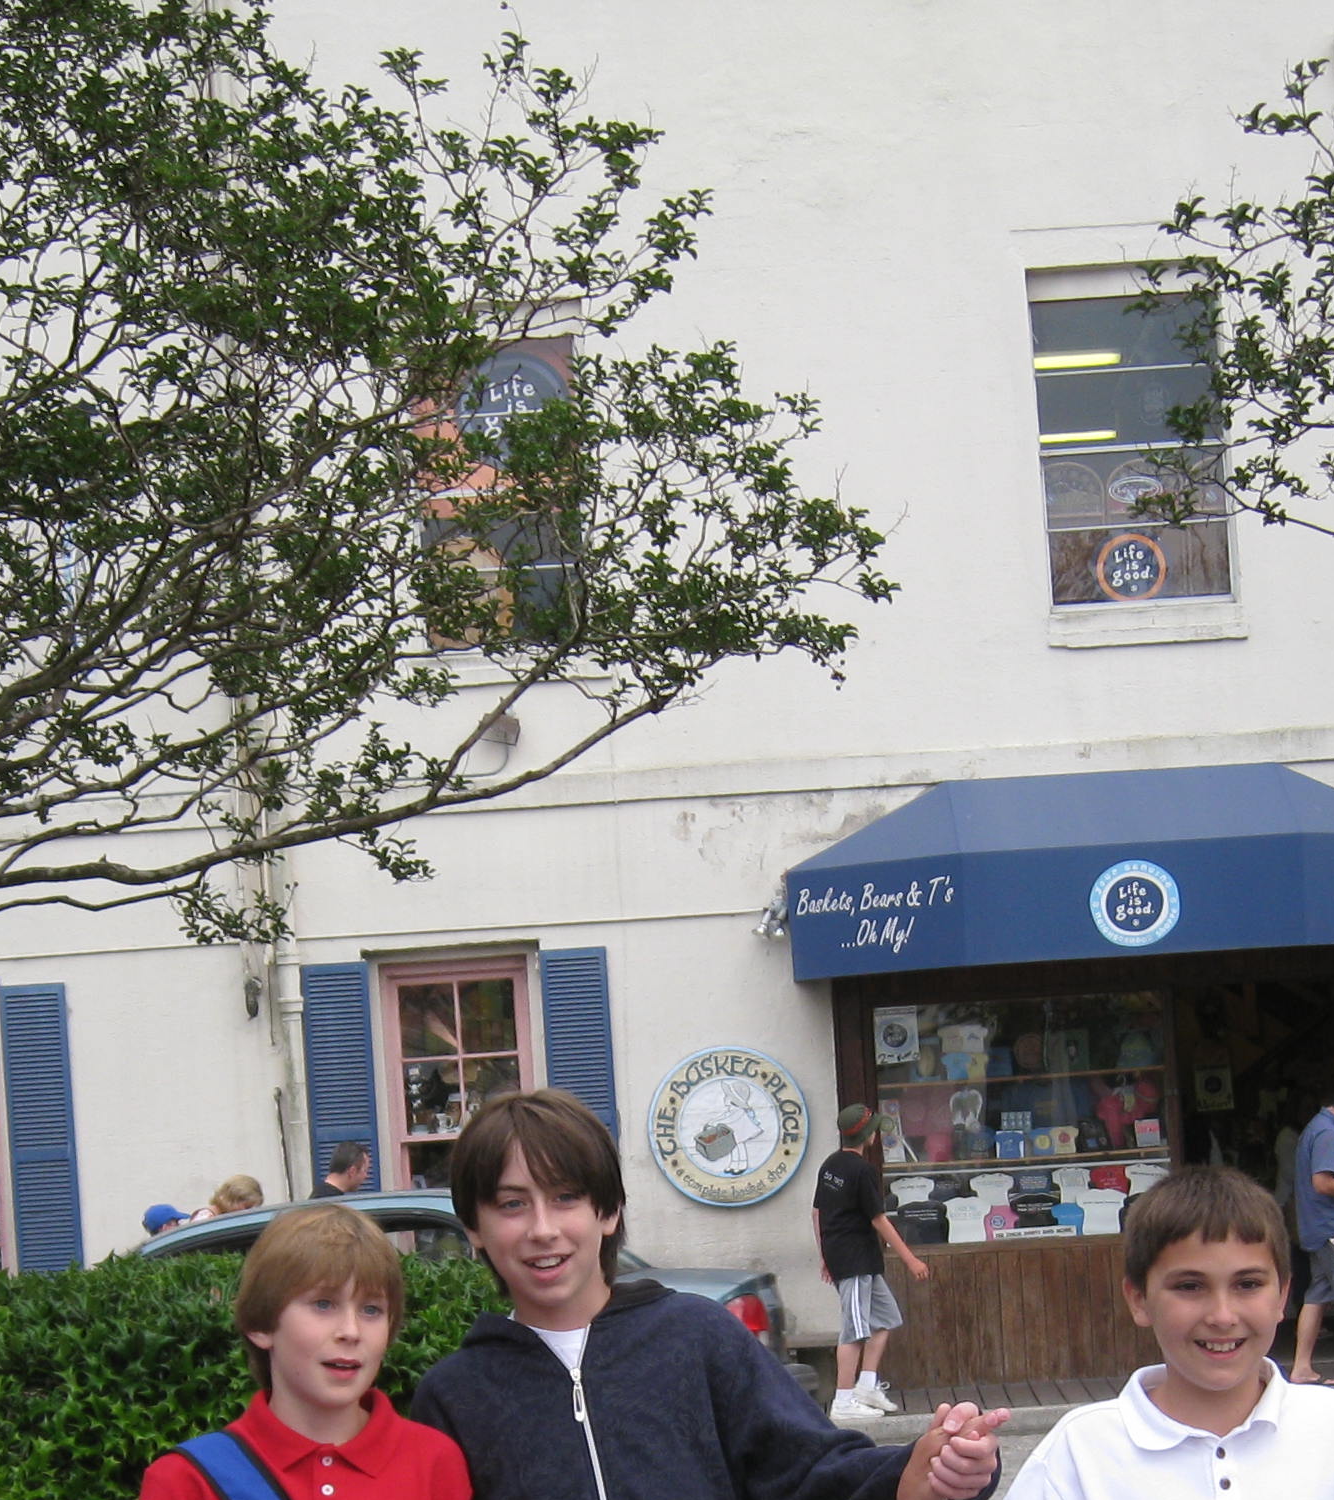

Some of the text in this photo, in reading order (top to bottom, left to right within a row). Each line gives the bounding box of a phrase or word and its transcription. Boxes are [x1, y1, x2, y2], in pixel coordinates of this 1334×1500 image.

[488, 374, 536, 402] Life
[507, 398, 528, 414] is
[1114, 544, 1144, 563] Life
[1126, 560, 1139, 571] is
[1112, 565, 1153, 587] good.
[796, 875, 954, 916] Baskets, Bears & T's
[1118, 881, 1146, 899] Life
[1115, 901, 1154, 921] good.
[1129, 896, 1142, 906] is
[880, 916, 916, 953] My!
[656, 1054, 802, 1161] THE BASKET PLACE
[767, 1162, 788, 1183] shop
